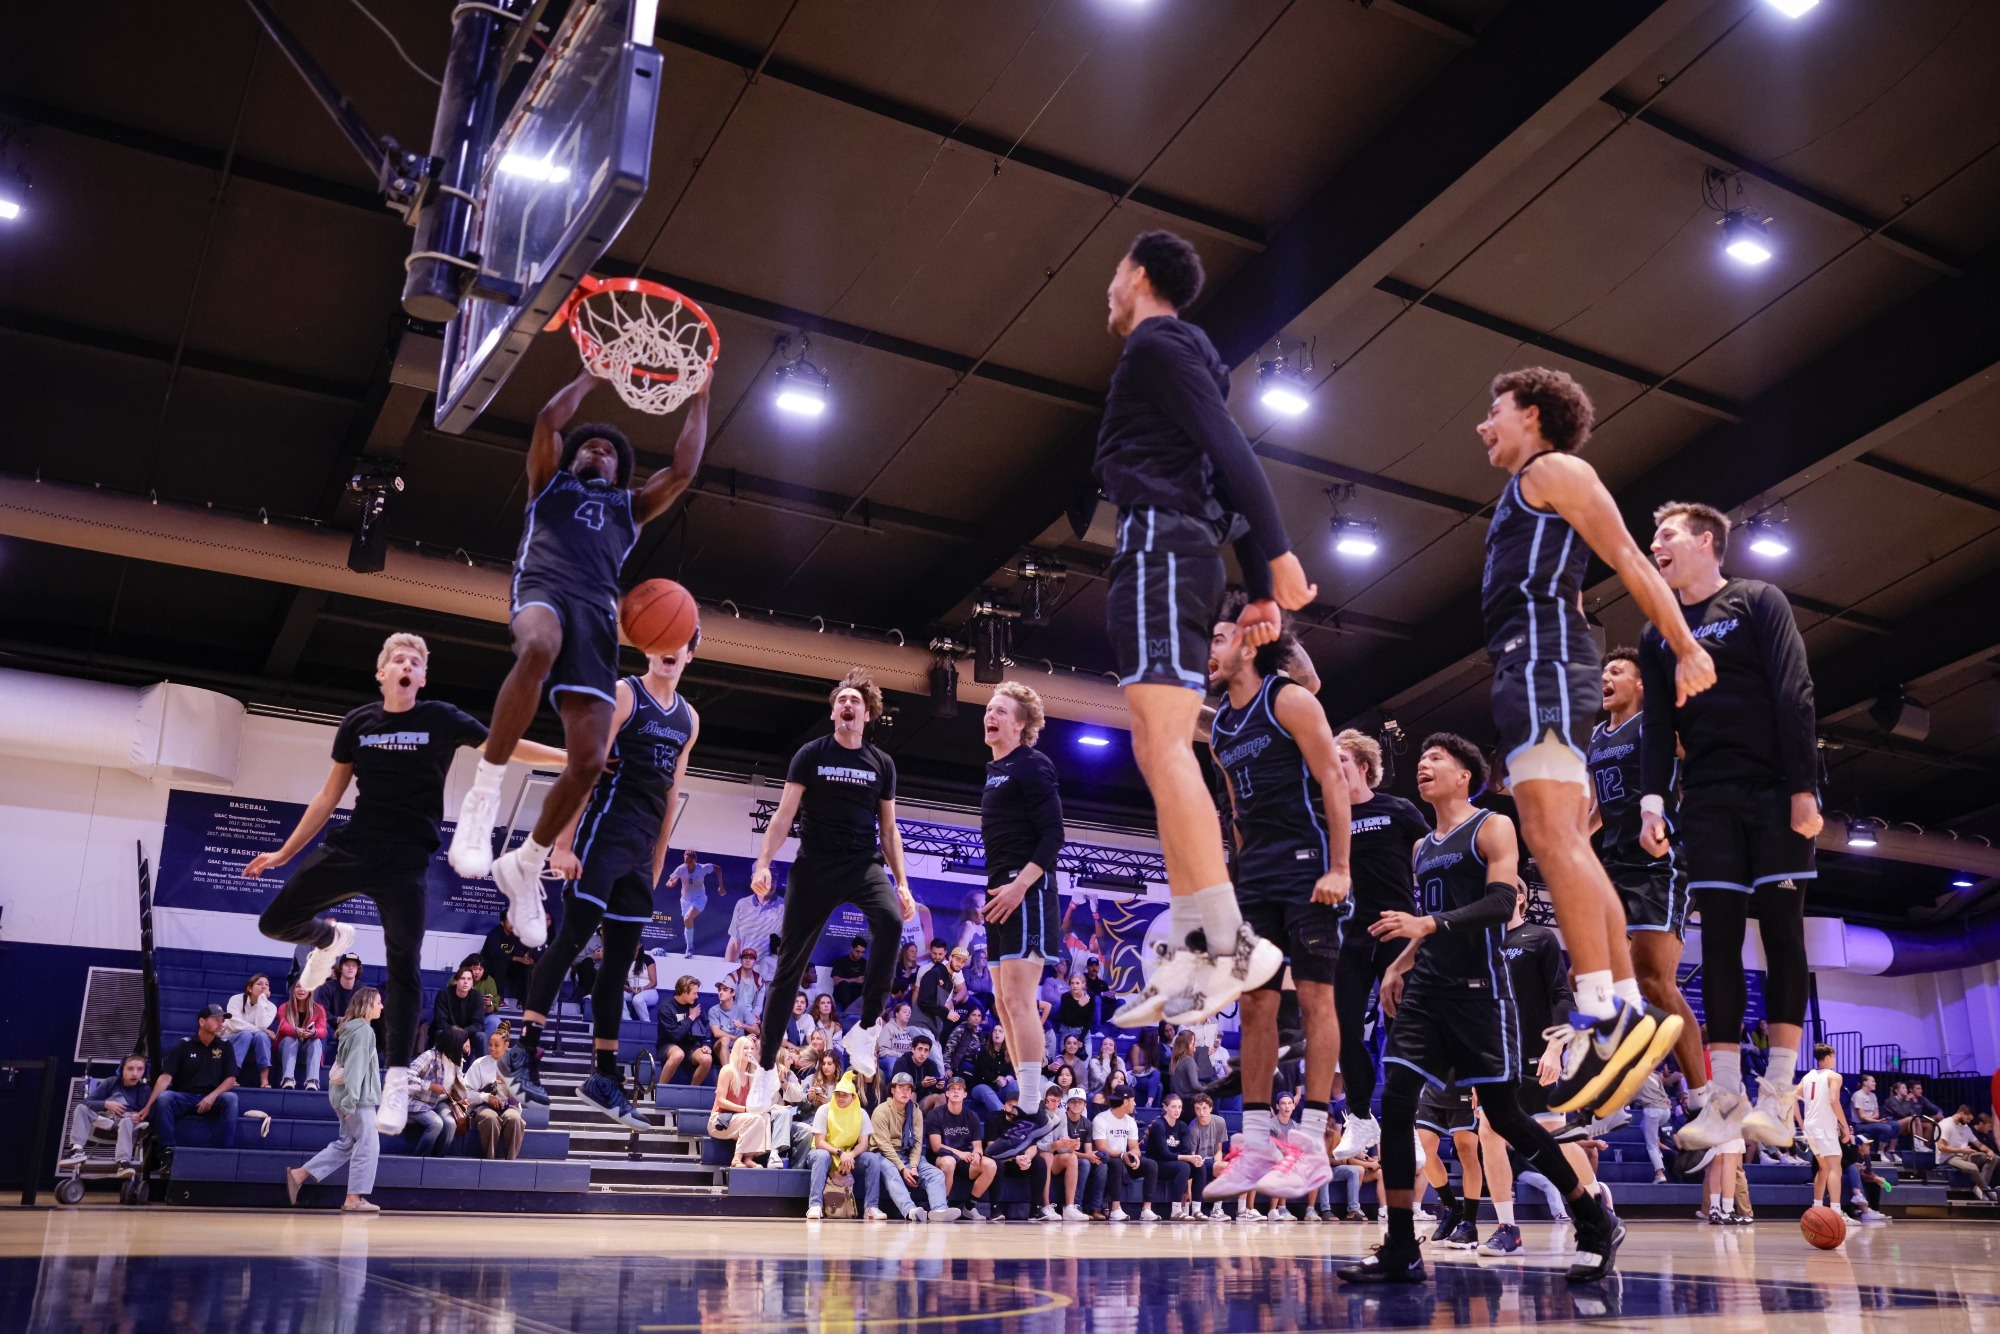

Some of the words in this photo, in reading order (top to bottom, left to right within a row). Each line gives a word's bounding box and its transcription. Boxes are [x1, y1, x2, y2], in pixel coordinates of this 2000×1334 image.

[574, 500, 604, 530] 4
[1150, 639, 1169, 656] M
[1538, 708, 1560, 723] M
[638, 720, 688, 745] Mustangs
[826, 776, 868, 784] BASKETBALL
[1596, 766, 1625, 803] 12
[230, 802, 268, 811] BASEBALL
[231, 849, 270, 857] BASKET
[1426, 878, 1443, 914] 0
[1028, 934, 1040, 946] M
[1811, 1082, 1816, 1100] 1
